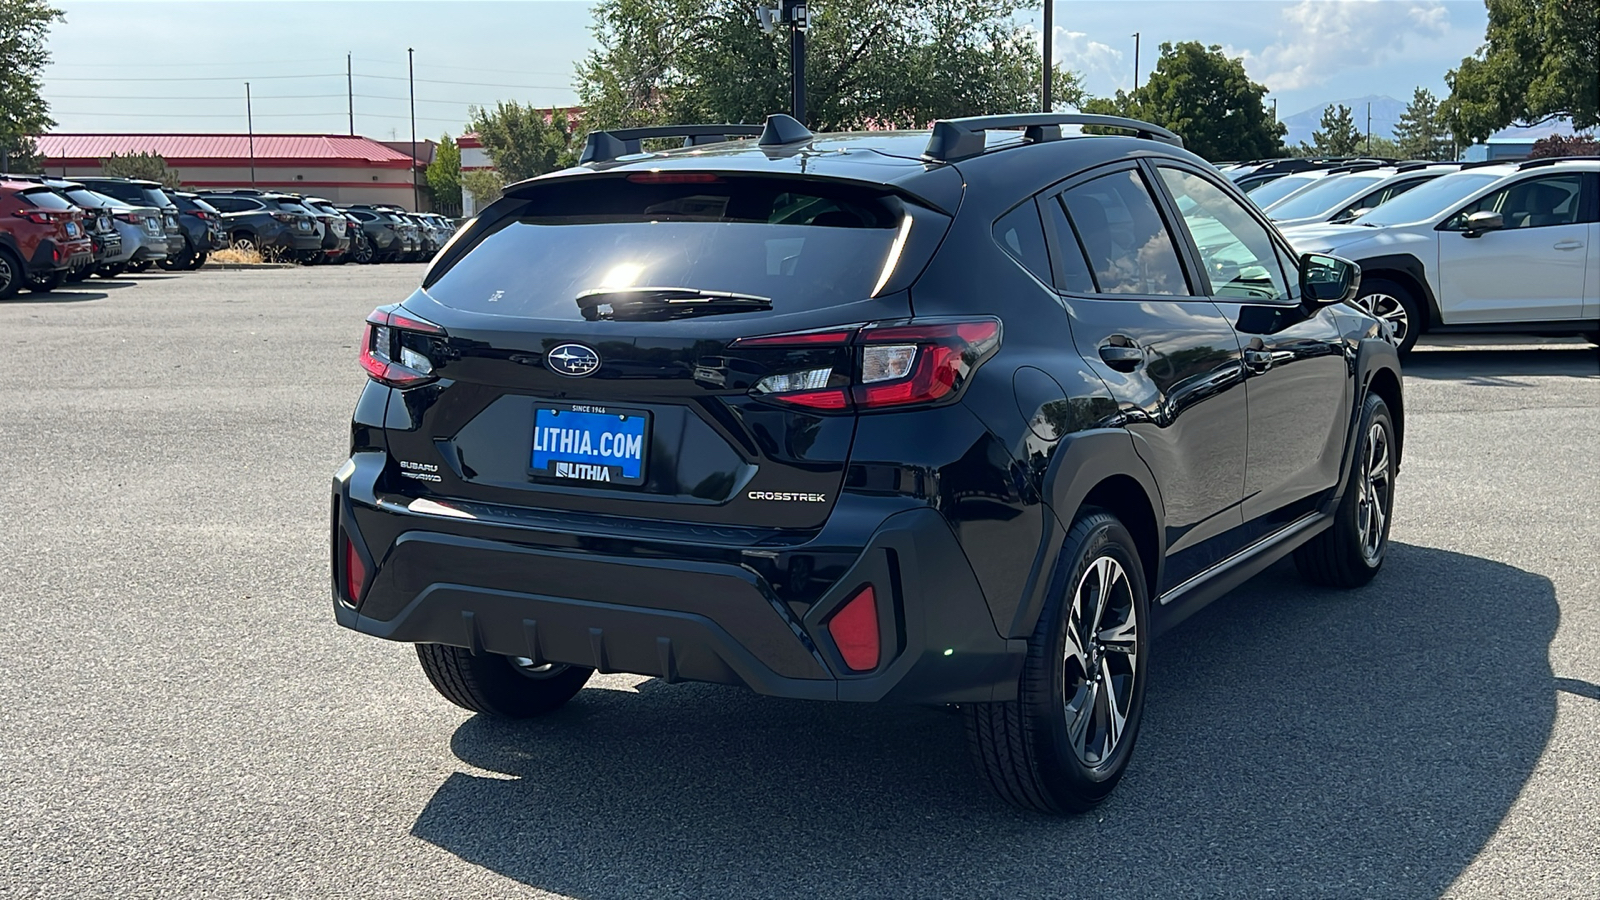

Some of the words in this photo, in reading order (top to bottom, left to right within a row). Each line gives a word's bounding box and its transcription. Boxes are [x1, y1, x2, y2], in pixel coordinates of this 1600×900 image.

[572, 405, 590, 413] SINCE
[591, 406, 606, 414] 1946
[533, 426, 642, 460] LITHIA.COM
[400, 461, 438, 472] SUBARU
[568, 463, 611, 482] LITHIA
[748, 491, 826, 502] CROSSTREK
